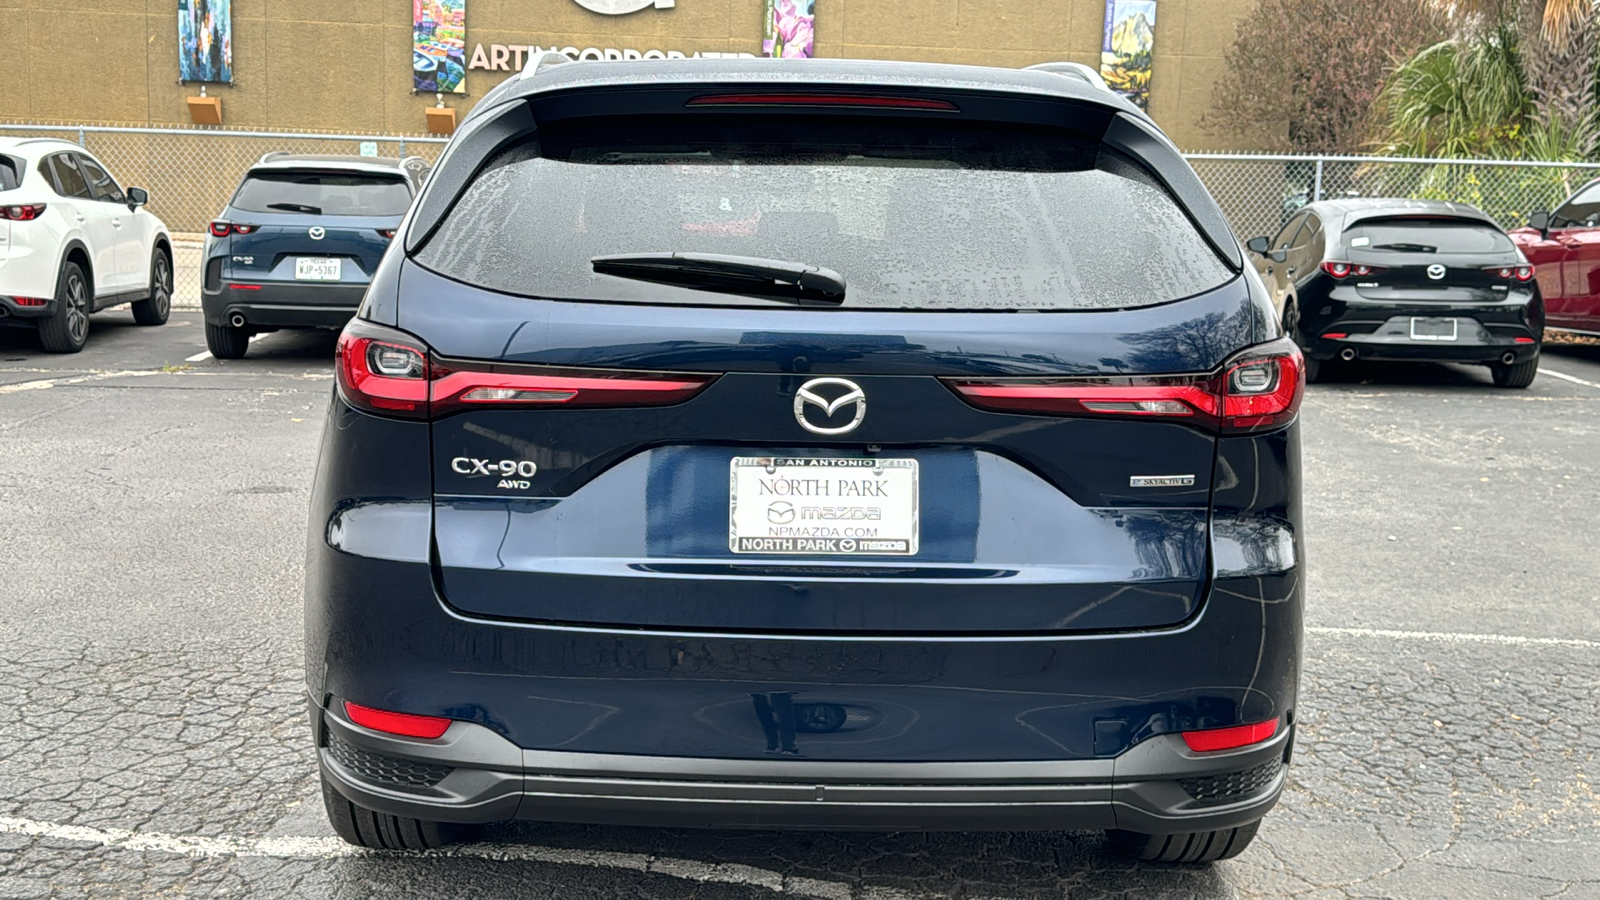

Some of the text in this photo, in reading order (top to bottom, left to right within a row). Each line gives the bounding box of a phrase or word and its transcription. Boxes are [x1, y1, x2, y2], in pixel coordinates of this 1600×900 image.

[451, 457, 537, 478] CX-90
[809, 459, 873, 467] ANTONIO
[497, 479, 531, 490] AWD
[758, 477, 889, 497] NORTH PARK
[801, 506, 881, 520] mazda
[768, 526, 878, 538] NPMAZDA.COM
[741, 538, 907, 552] NORTH PARK mazda
